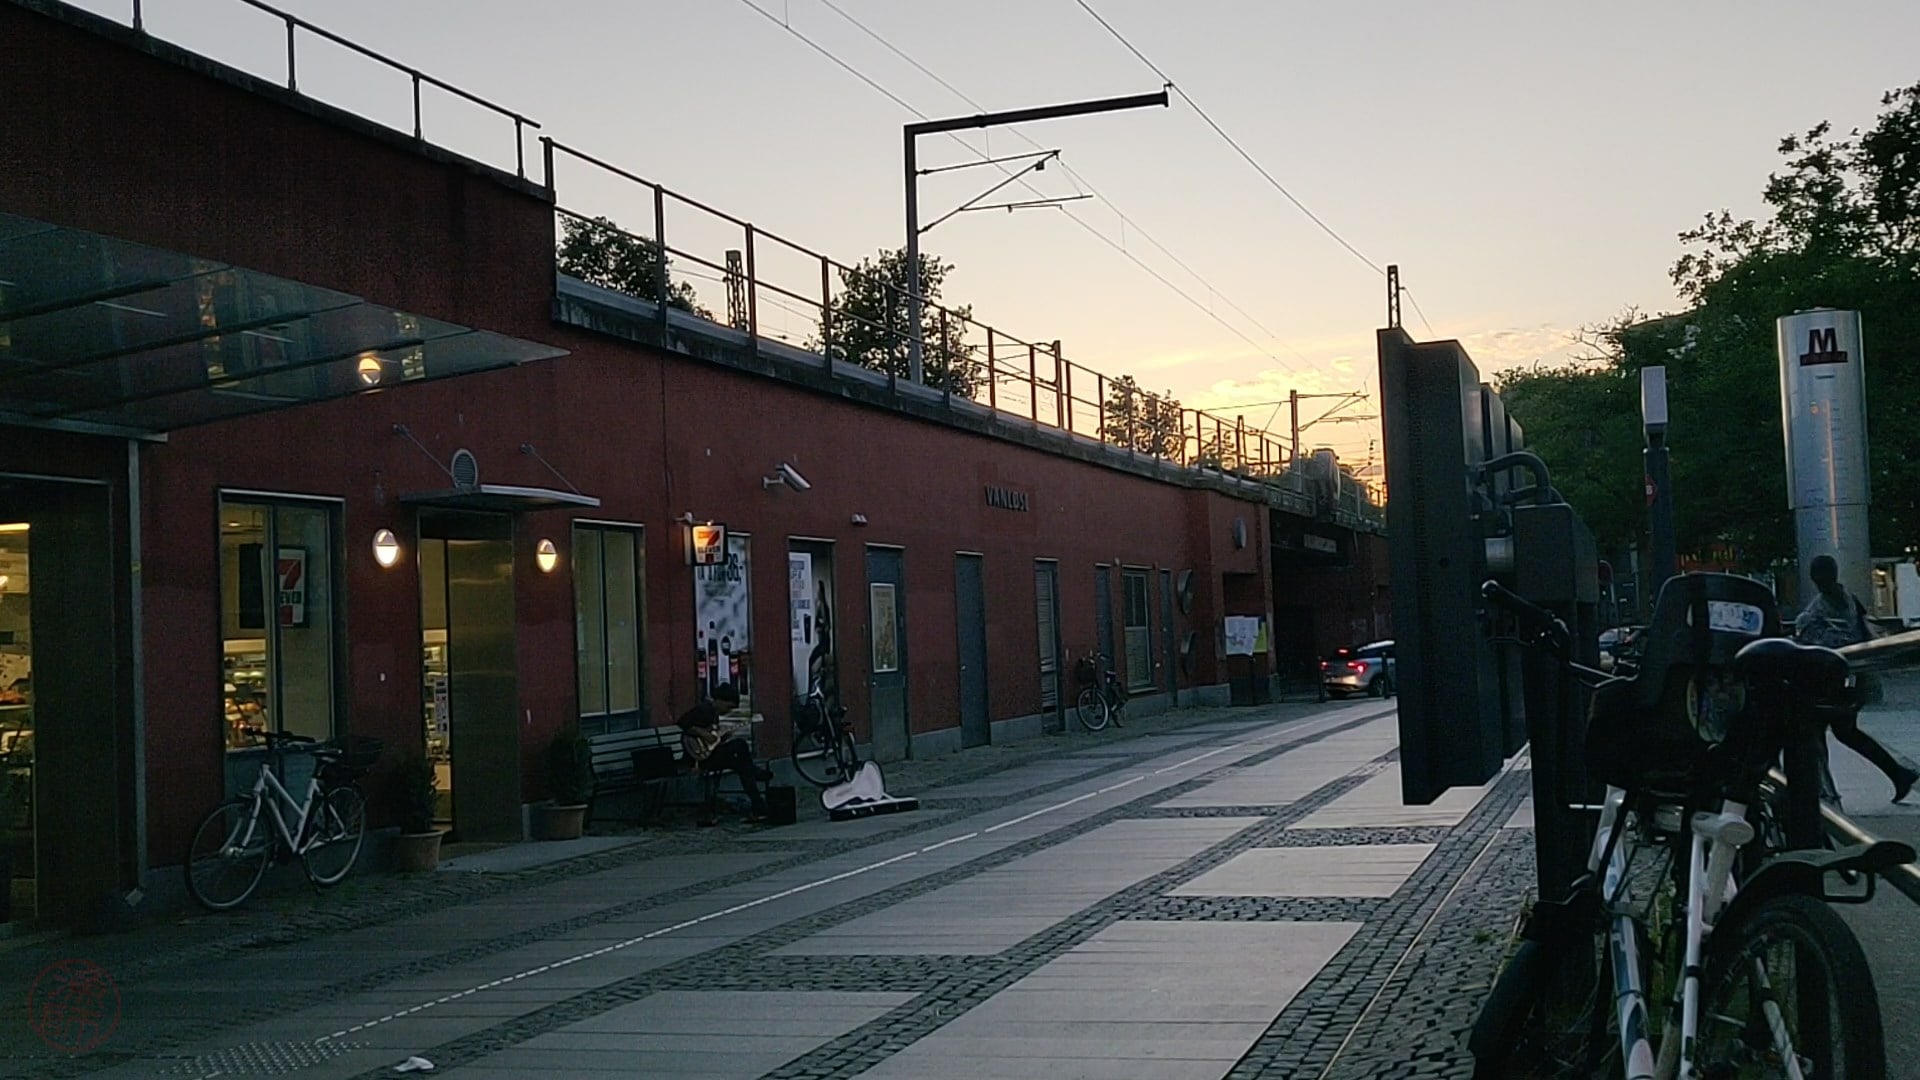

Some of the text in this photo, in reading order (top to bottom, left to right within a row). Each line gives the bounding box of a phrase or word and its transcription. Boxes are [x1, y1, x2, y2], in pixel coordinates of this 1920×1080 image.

[1800, 327, 1848, 366] M
[698, 530, 720, 546] 7
[278, 559, 301, 590] 7
